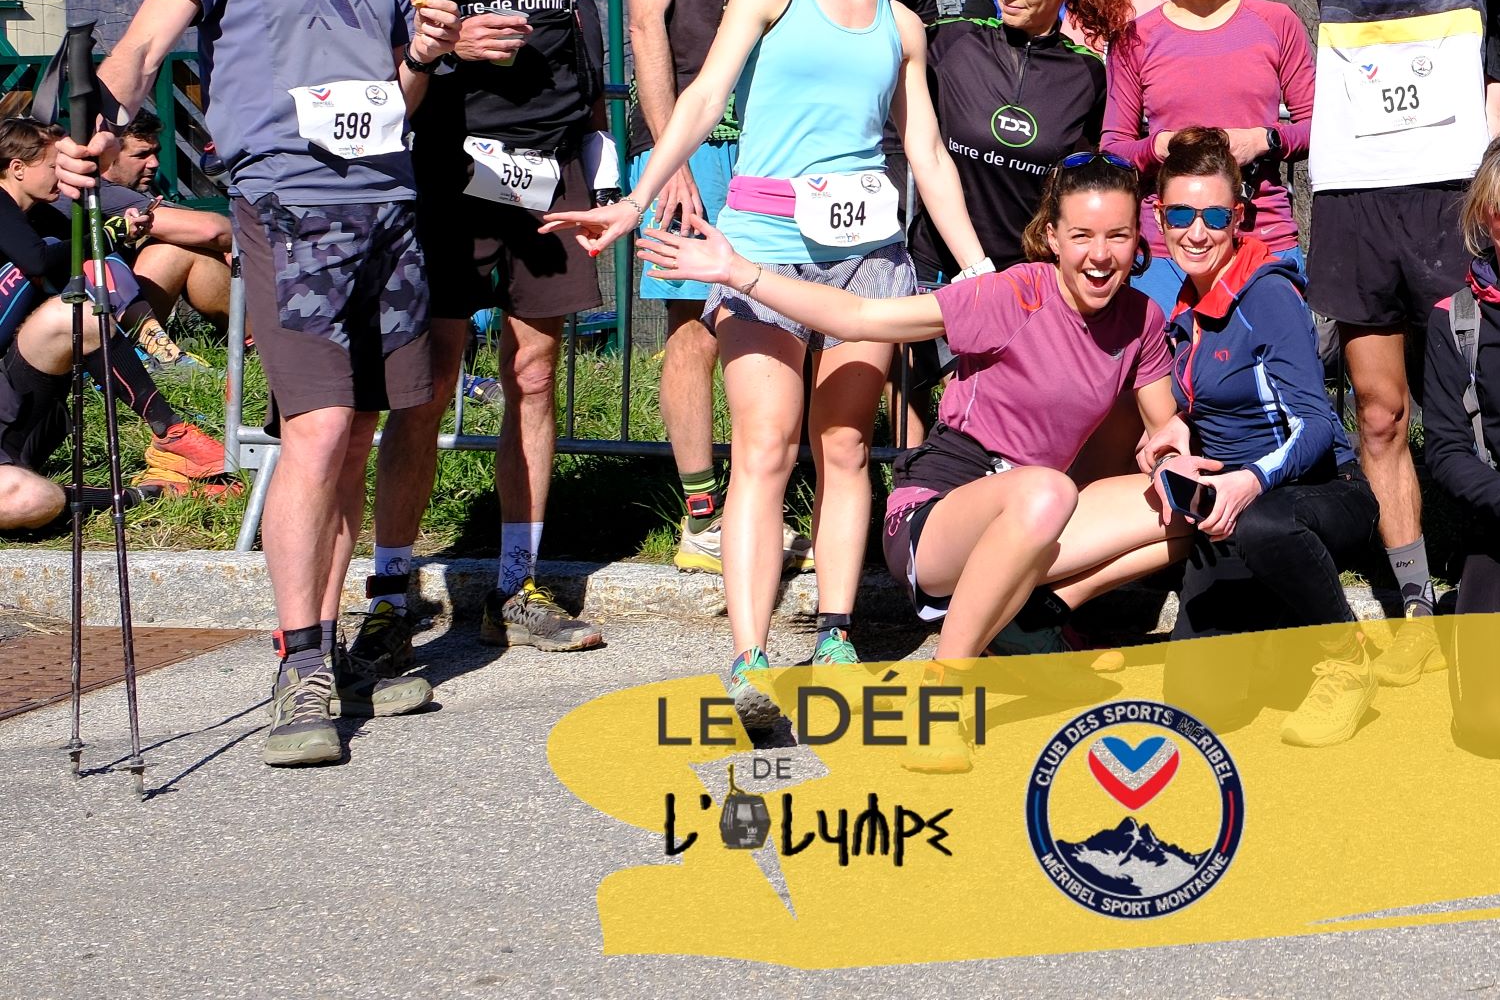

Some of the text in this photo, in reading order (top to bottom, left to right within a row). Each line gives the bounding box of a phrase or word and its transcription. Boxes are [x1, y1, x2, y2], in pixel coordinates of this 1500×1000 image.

[1381, 84, 1420, 114] 523
[333, 112, 372, 140] 598
[997, 114, 1032, 137] TDR
[948, 136, 1059, 179] terre de runnin
[501, 163, 533, 190] 595
[829, 200, 867, 229] 634
